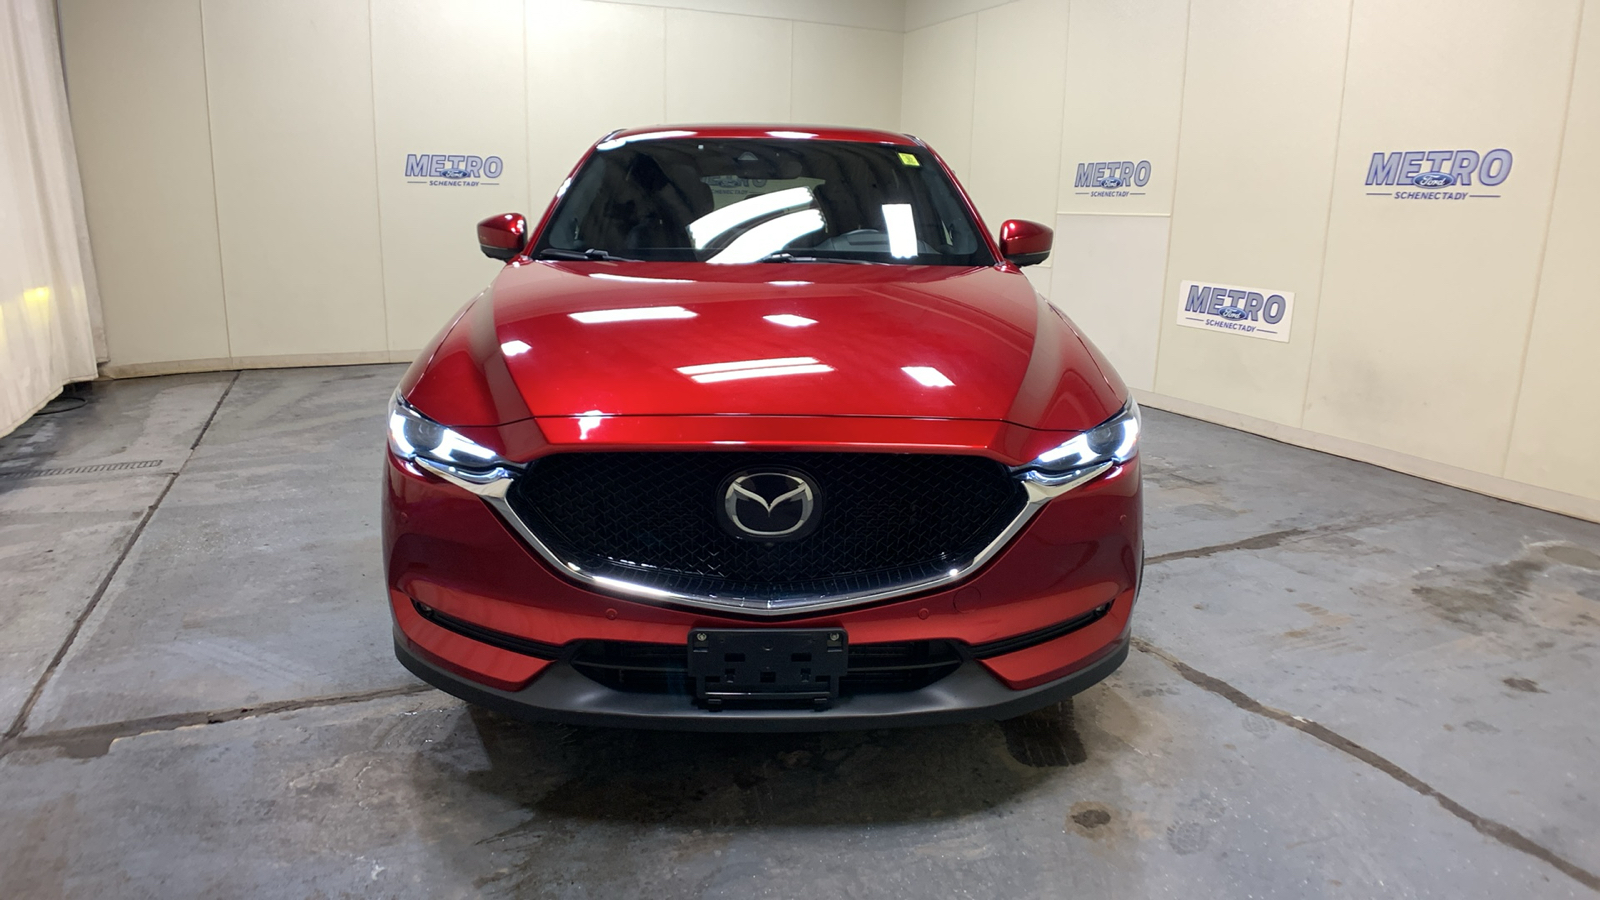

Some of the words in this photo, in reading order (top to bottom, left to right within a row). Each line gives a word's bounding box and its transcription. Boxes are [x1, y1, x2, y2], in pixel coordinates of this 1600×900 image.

[405, 154, 503, 178] METRO
[1074, 160, 1152, 187] METRO
[1364, 148, 1513, 186] METRO
[1419, 175, 1445, 186] Ford
[1394, 191, 1469, 200] SCHENECTADY
[1184, 284, 1286, 324] METRO
[1205, 319, 1256, 333] SCHENECTADY
